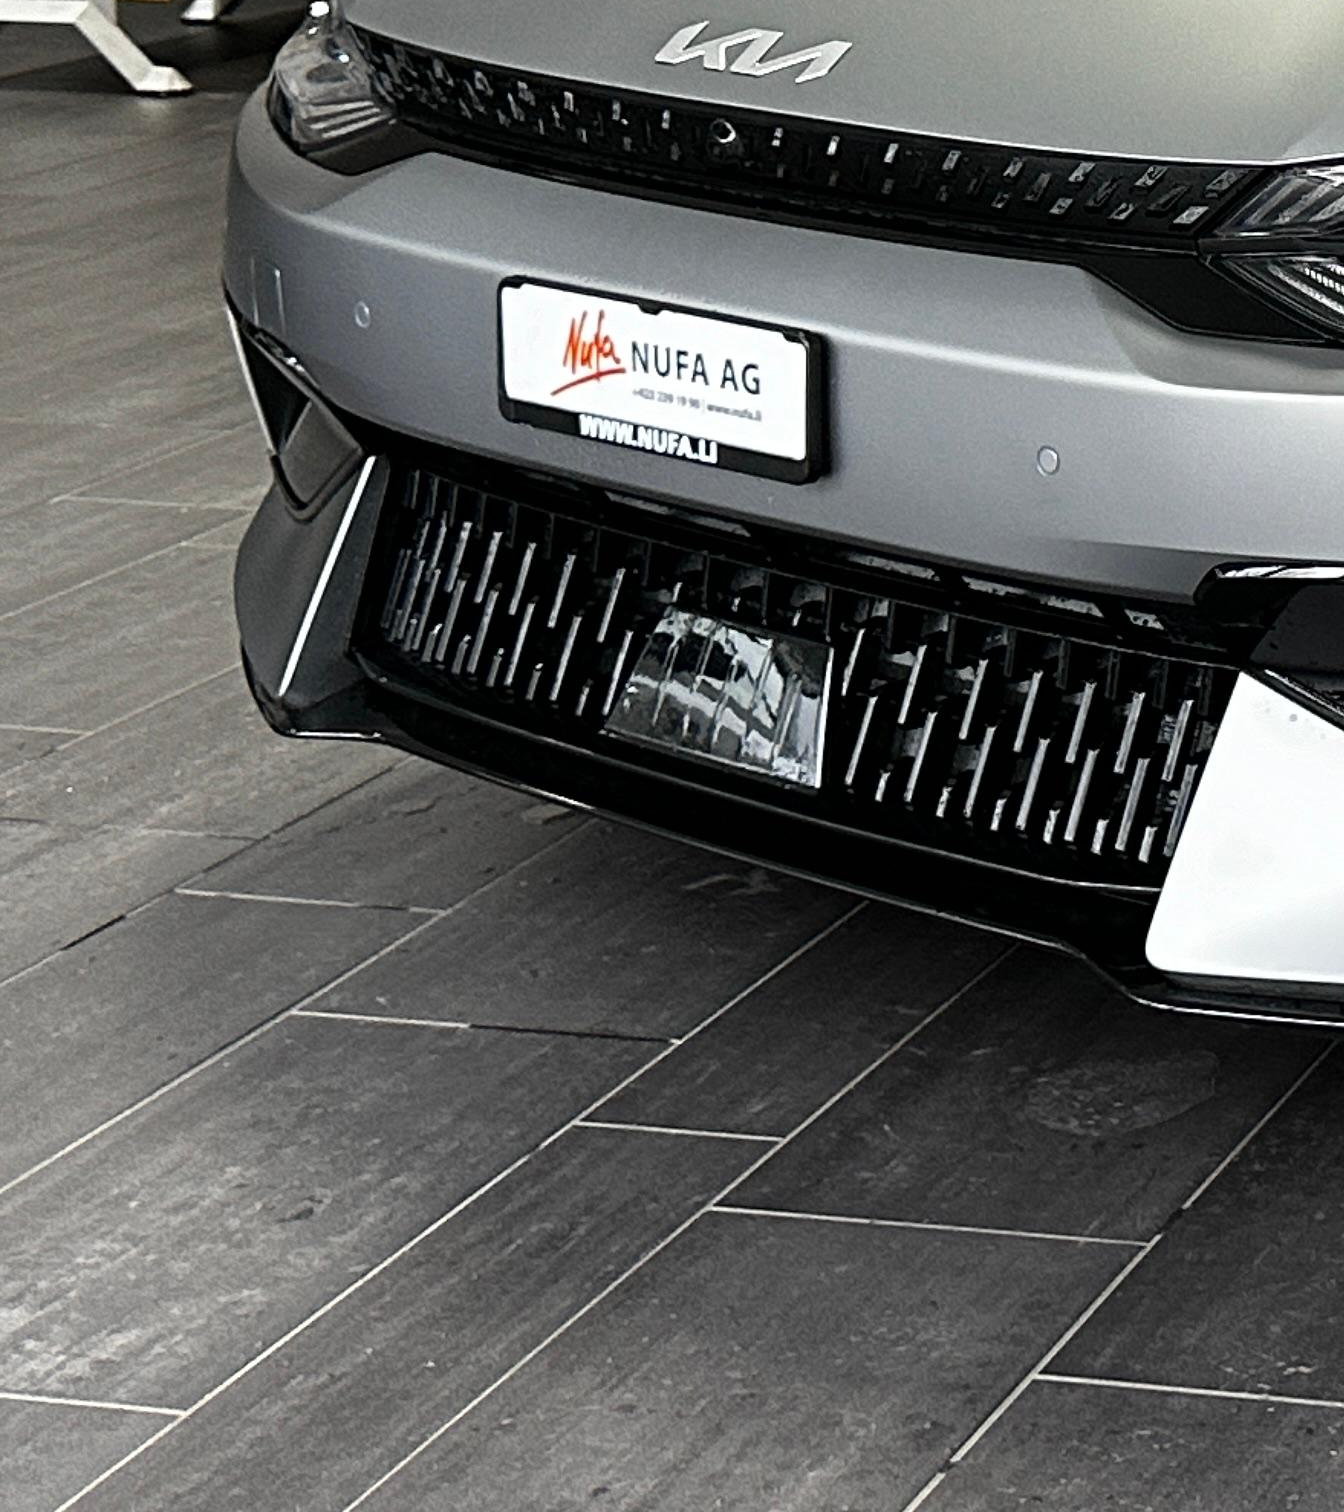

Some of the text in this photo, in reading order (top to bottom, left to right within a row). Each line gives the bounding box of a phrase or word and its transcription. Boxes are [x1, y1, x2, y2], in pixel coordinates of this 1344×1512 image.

[654, 20, 852, 84] KIA
[562, 309, 761, 395] Nufa NUFA AG
[578, 414, 719, 464] WWW.NUFA.LI
